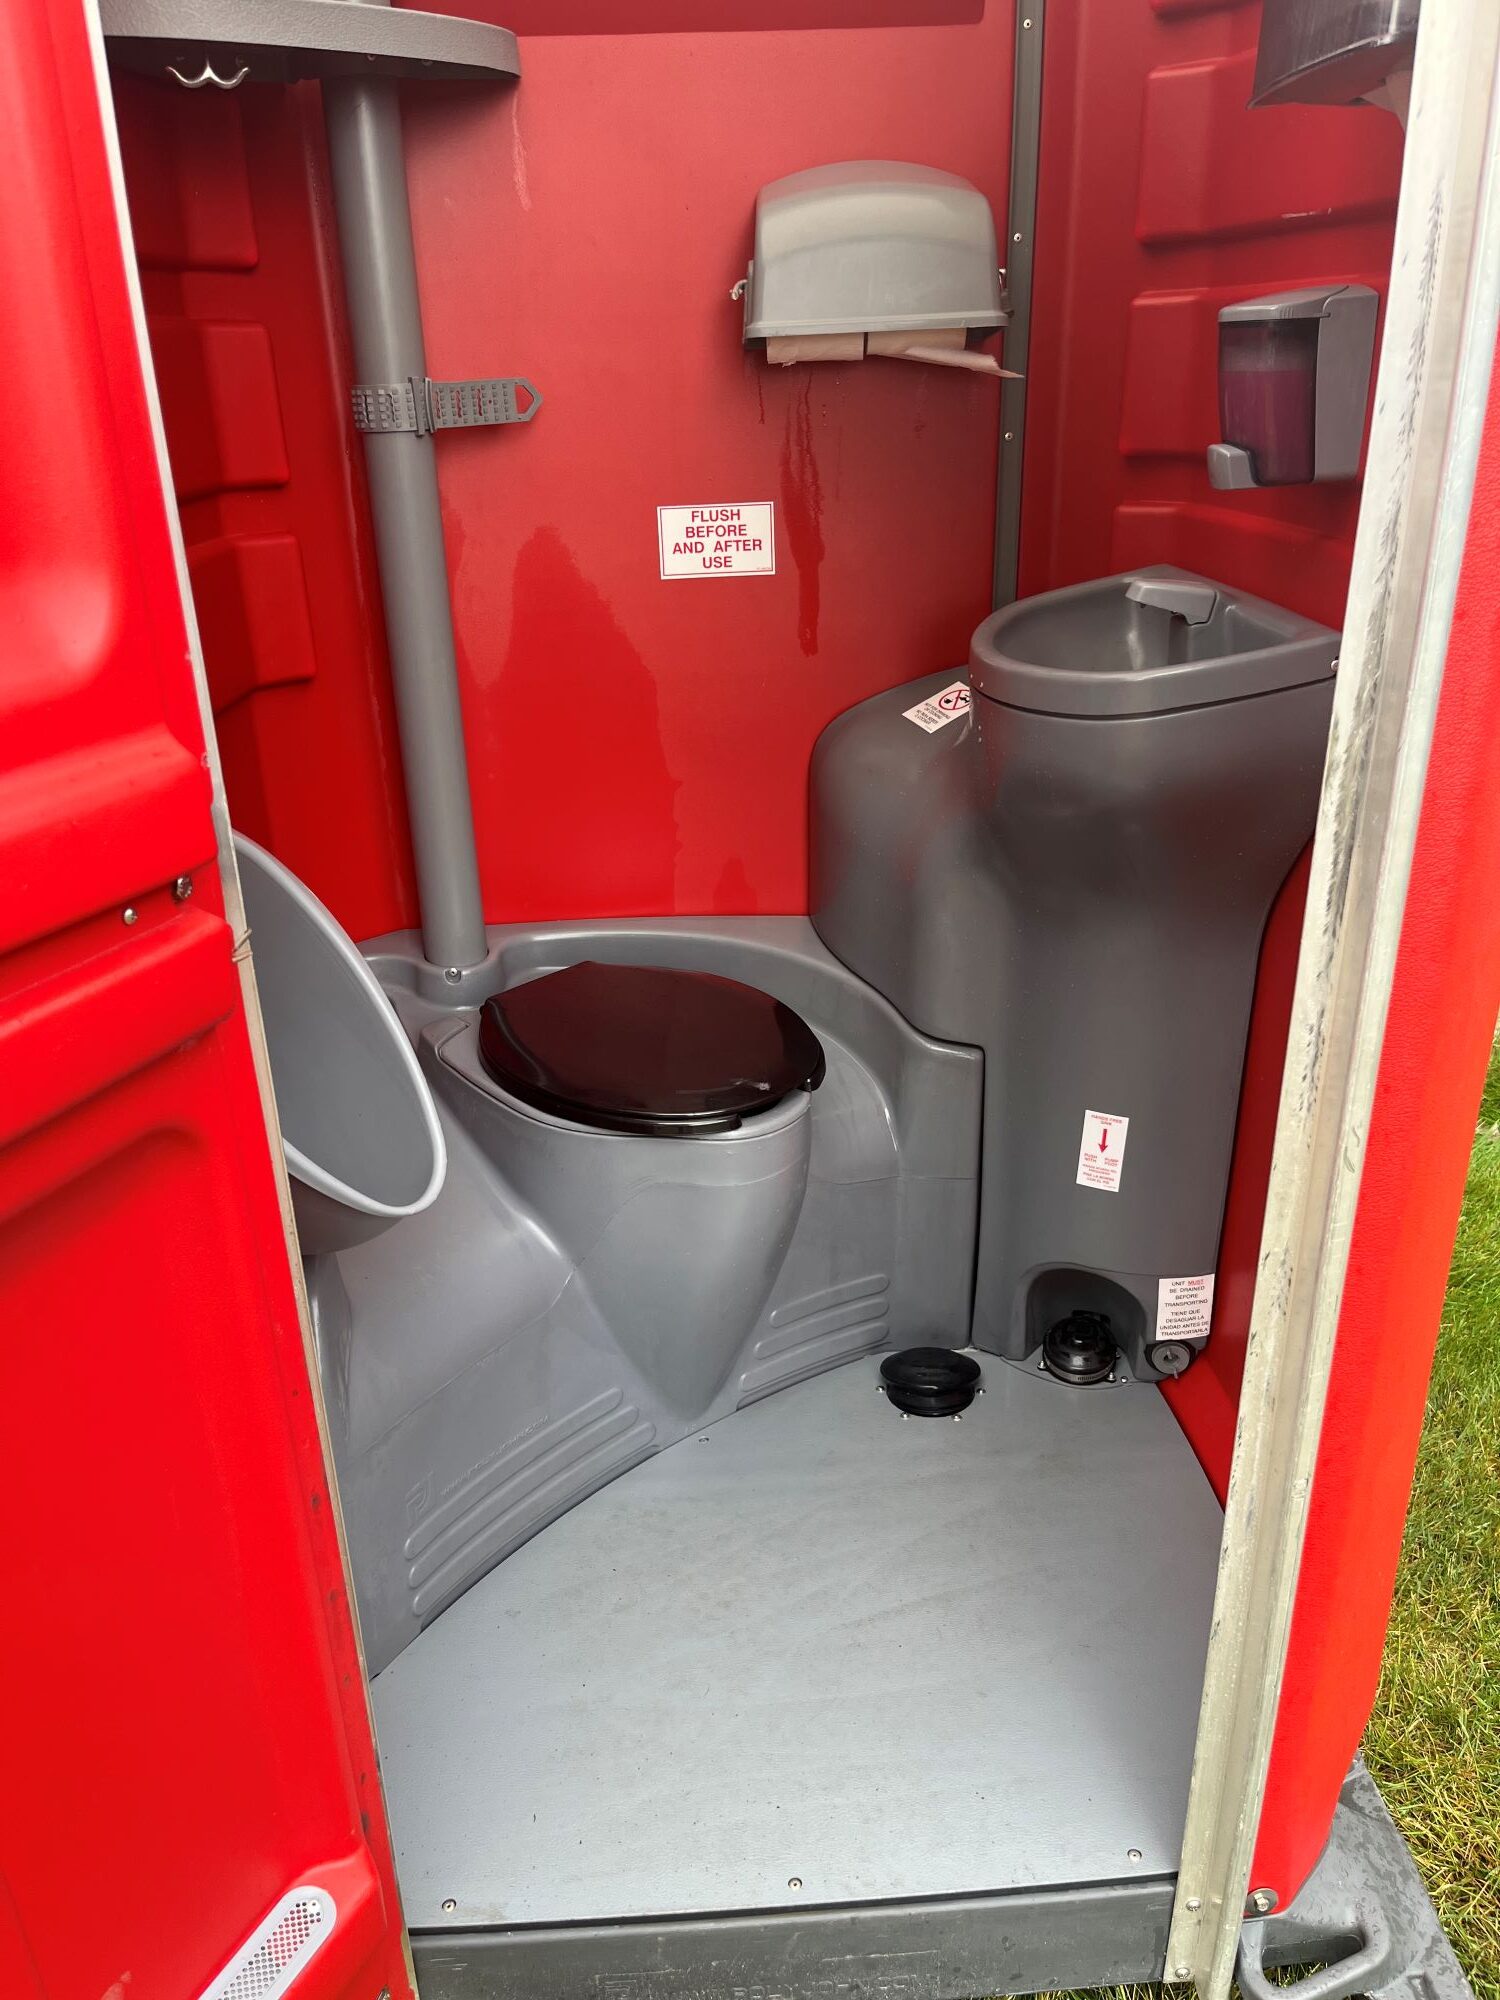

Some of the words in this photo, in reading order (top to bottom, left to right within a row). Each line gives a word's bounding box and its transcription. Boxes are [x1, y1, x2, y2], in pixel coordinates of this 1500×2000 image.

[692, 509, 740, 522] FLUSH
[686, 524, 747, 538] BEFORE
[673, 542, 704, 554] AND
[714, 539, 762, 552] AFTER
[703, 556, 732, 568] USE
[1165, 1299, 1208, 1307] TRANSPORTING
[1160, 1328, 1207, 1336] TRANSPORTARLA
